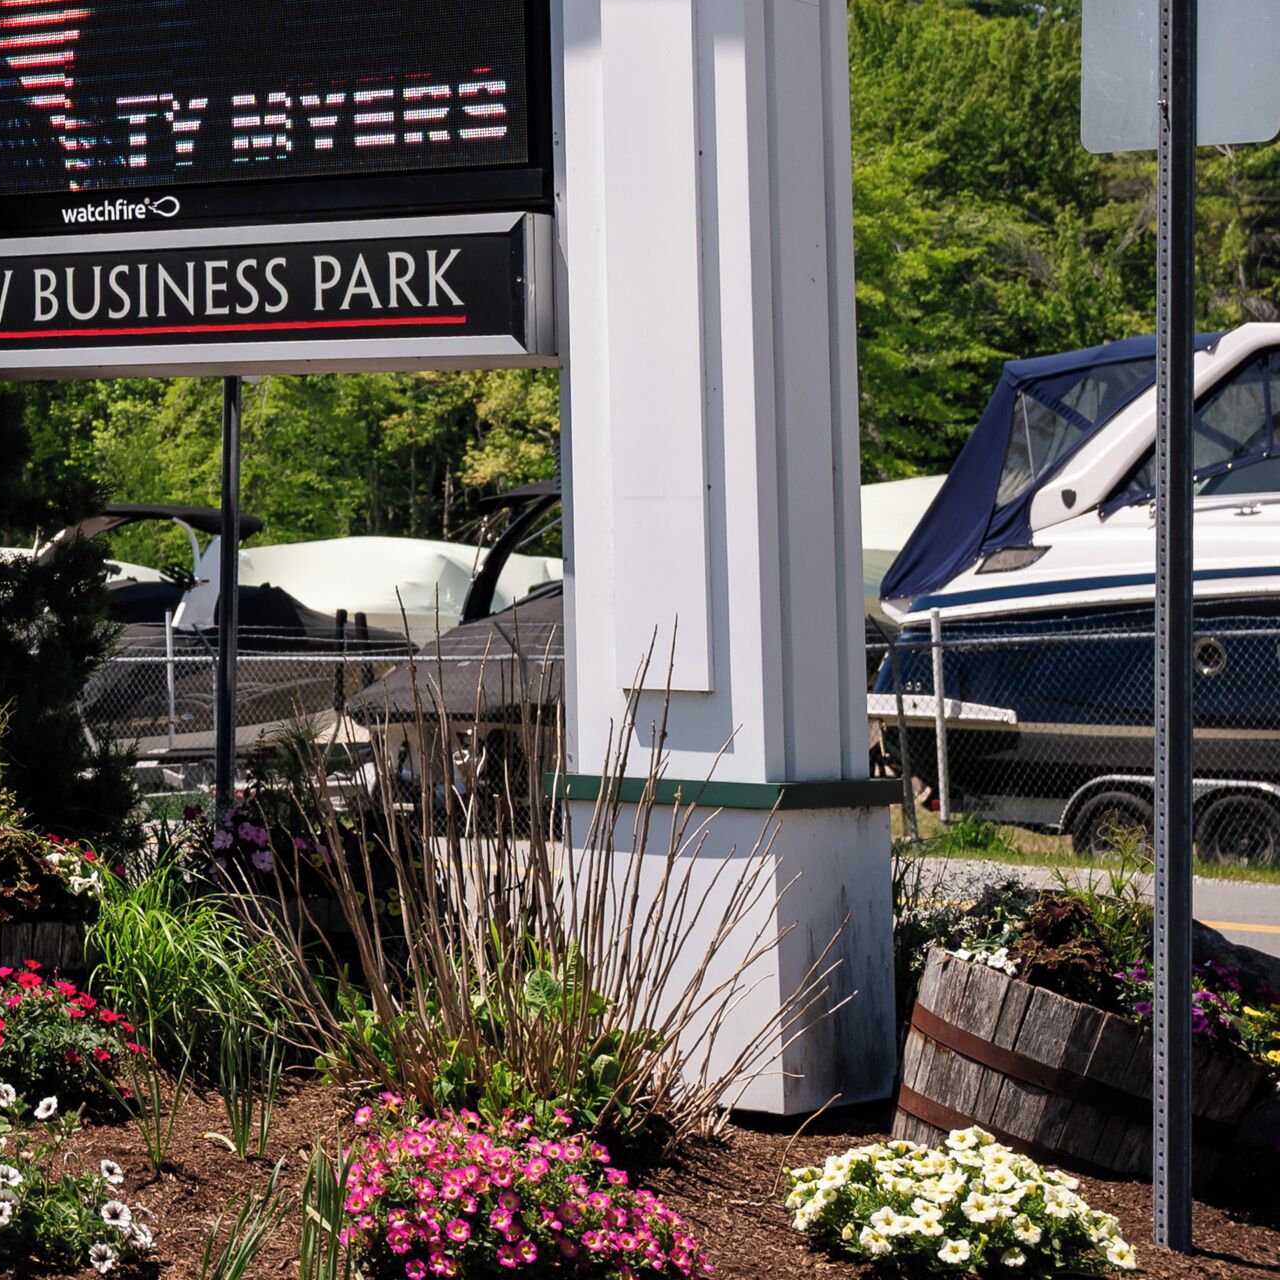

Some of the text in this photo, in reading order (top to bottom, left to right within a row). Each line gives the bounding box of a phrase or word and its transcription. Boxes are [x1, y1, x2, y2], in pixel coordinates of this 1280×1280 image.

[115, 91, 209, 168] TY
[34, 256, 288, 321] BUSINESS
[313, 247, 465, 312] PARK
